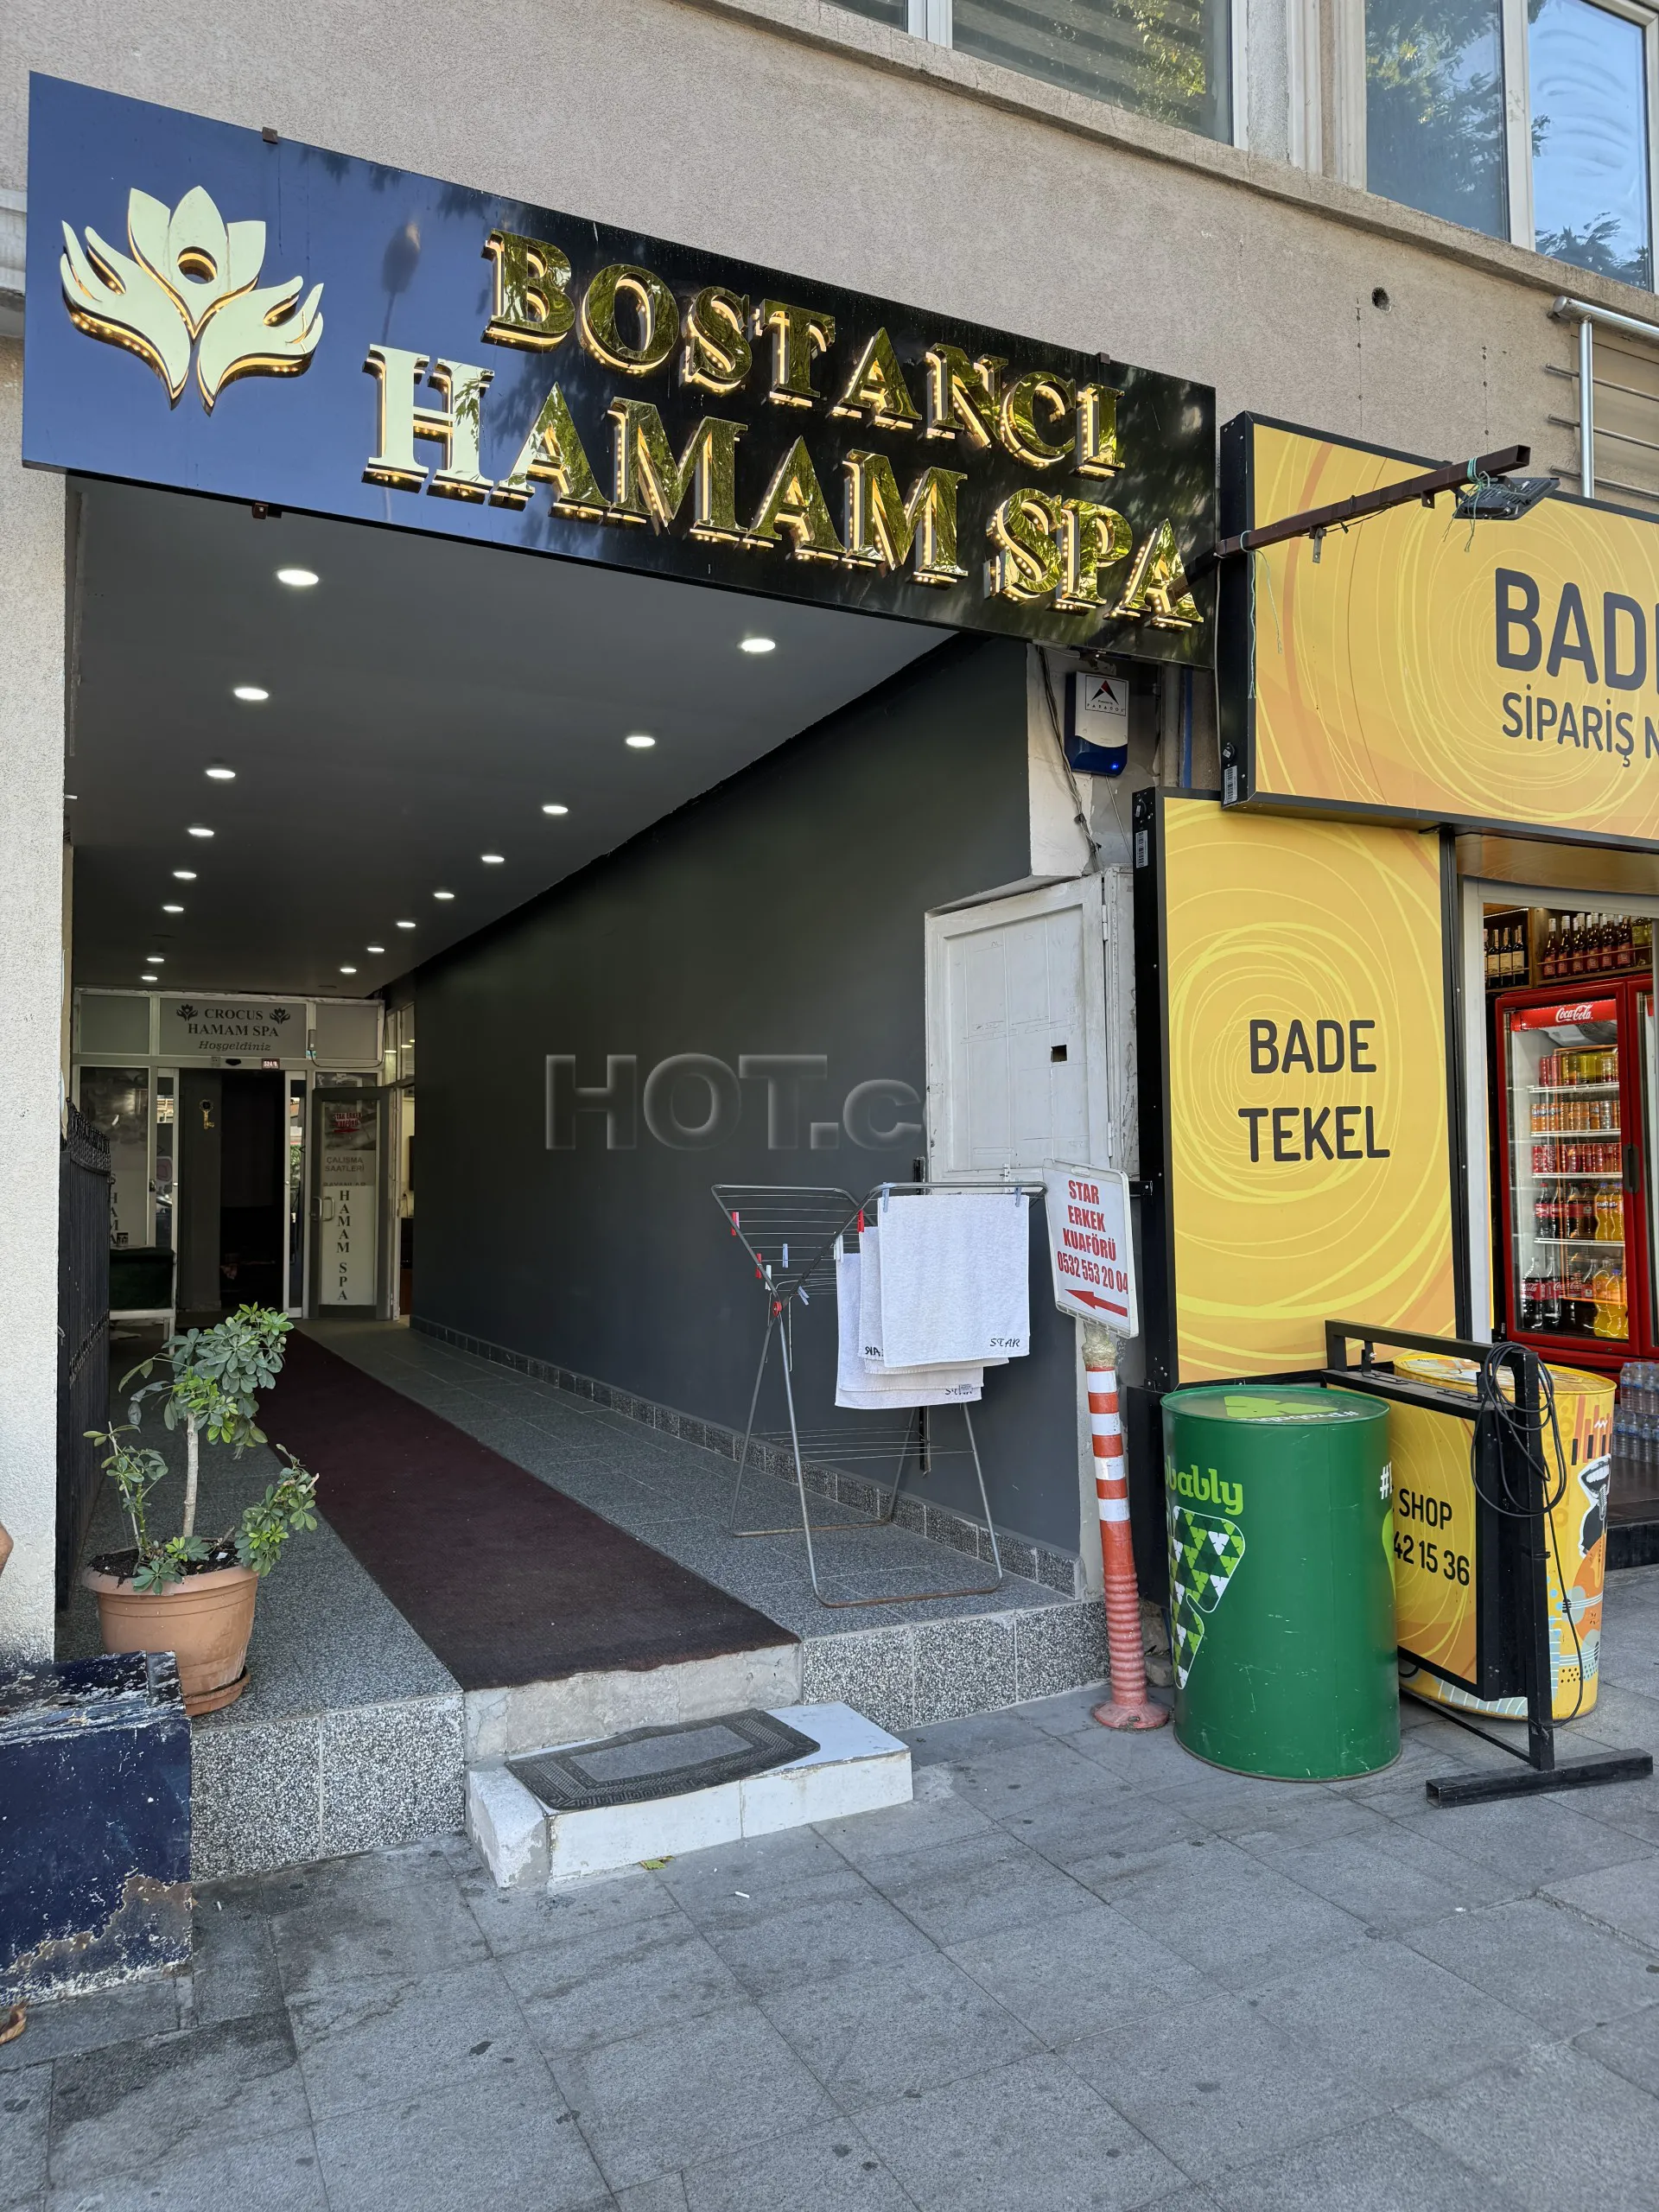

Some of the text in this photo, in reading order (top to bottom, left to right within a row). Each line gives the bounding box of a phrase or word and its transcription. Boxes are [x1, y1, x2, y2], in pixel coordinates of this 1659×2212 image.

[481, 228, 1125, 475] BOSTANCI
[362, 344, 1205, 629] HAMAM SPA
[1496, 567, 1659, 696] BAD
[1502, 683, 1635, 768] SİPARİŞ
[188, 1023, 279, 1037] HAMAM SPA
[204, 1008, 264, 1020] CROCUS
[1555, 1004, 1594, 1023] Coca-Cola
[199, 1040, 272, 1052] Hoşgeldiniz
[1249, 1019, 1377, 1074] BADE
[1238, 1105, 1390, 1163] TEKEL
[1068, 1179, 1100, 1205] STAR
[1067, 1205, 1106, 1233] ERKEK
[336, 1190, 351, 1301] HAMAM SPA
[1062, 1228, 1116, 1262] KUAFÖRÜ
[1057, 1250, 1129, 1295] 0532 553 20 04
[989, 1338, 1020, 1348] STAR
[1398, 1488, 1452, 1530] SHOP
[1419, 1540, 1439, 1573] 15
[1443, 1549, 1470, 1586] 36
